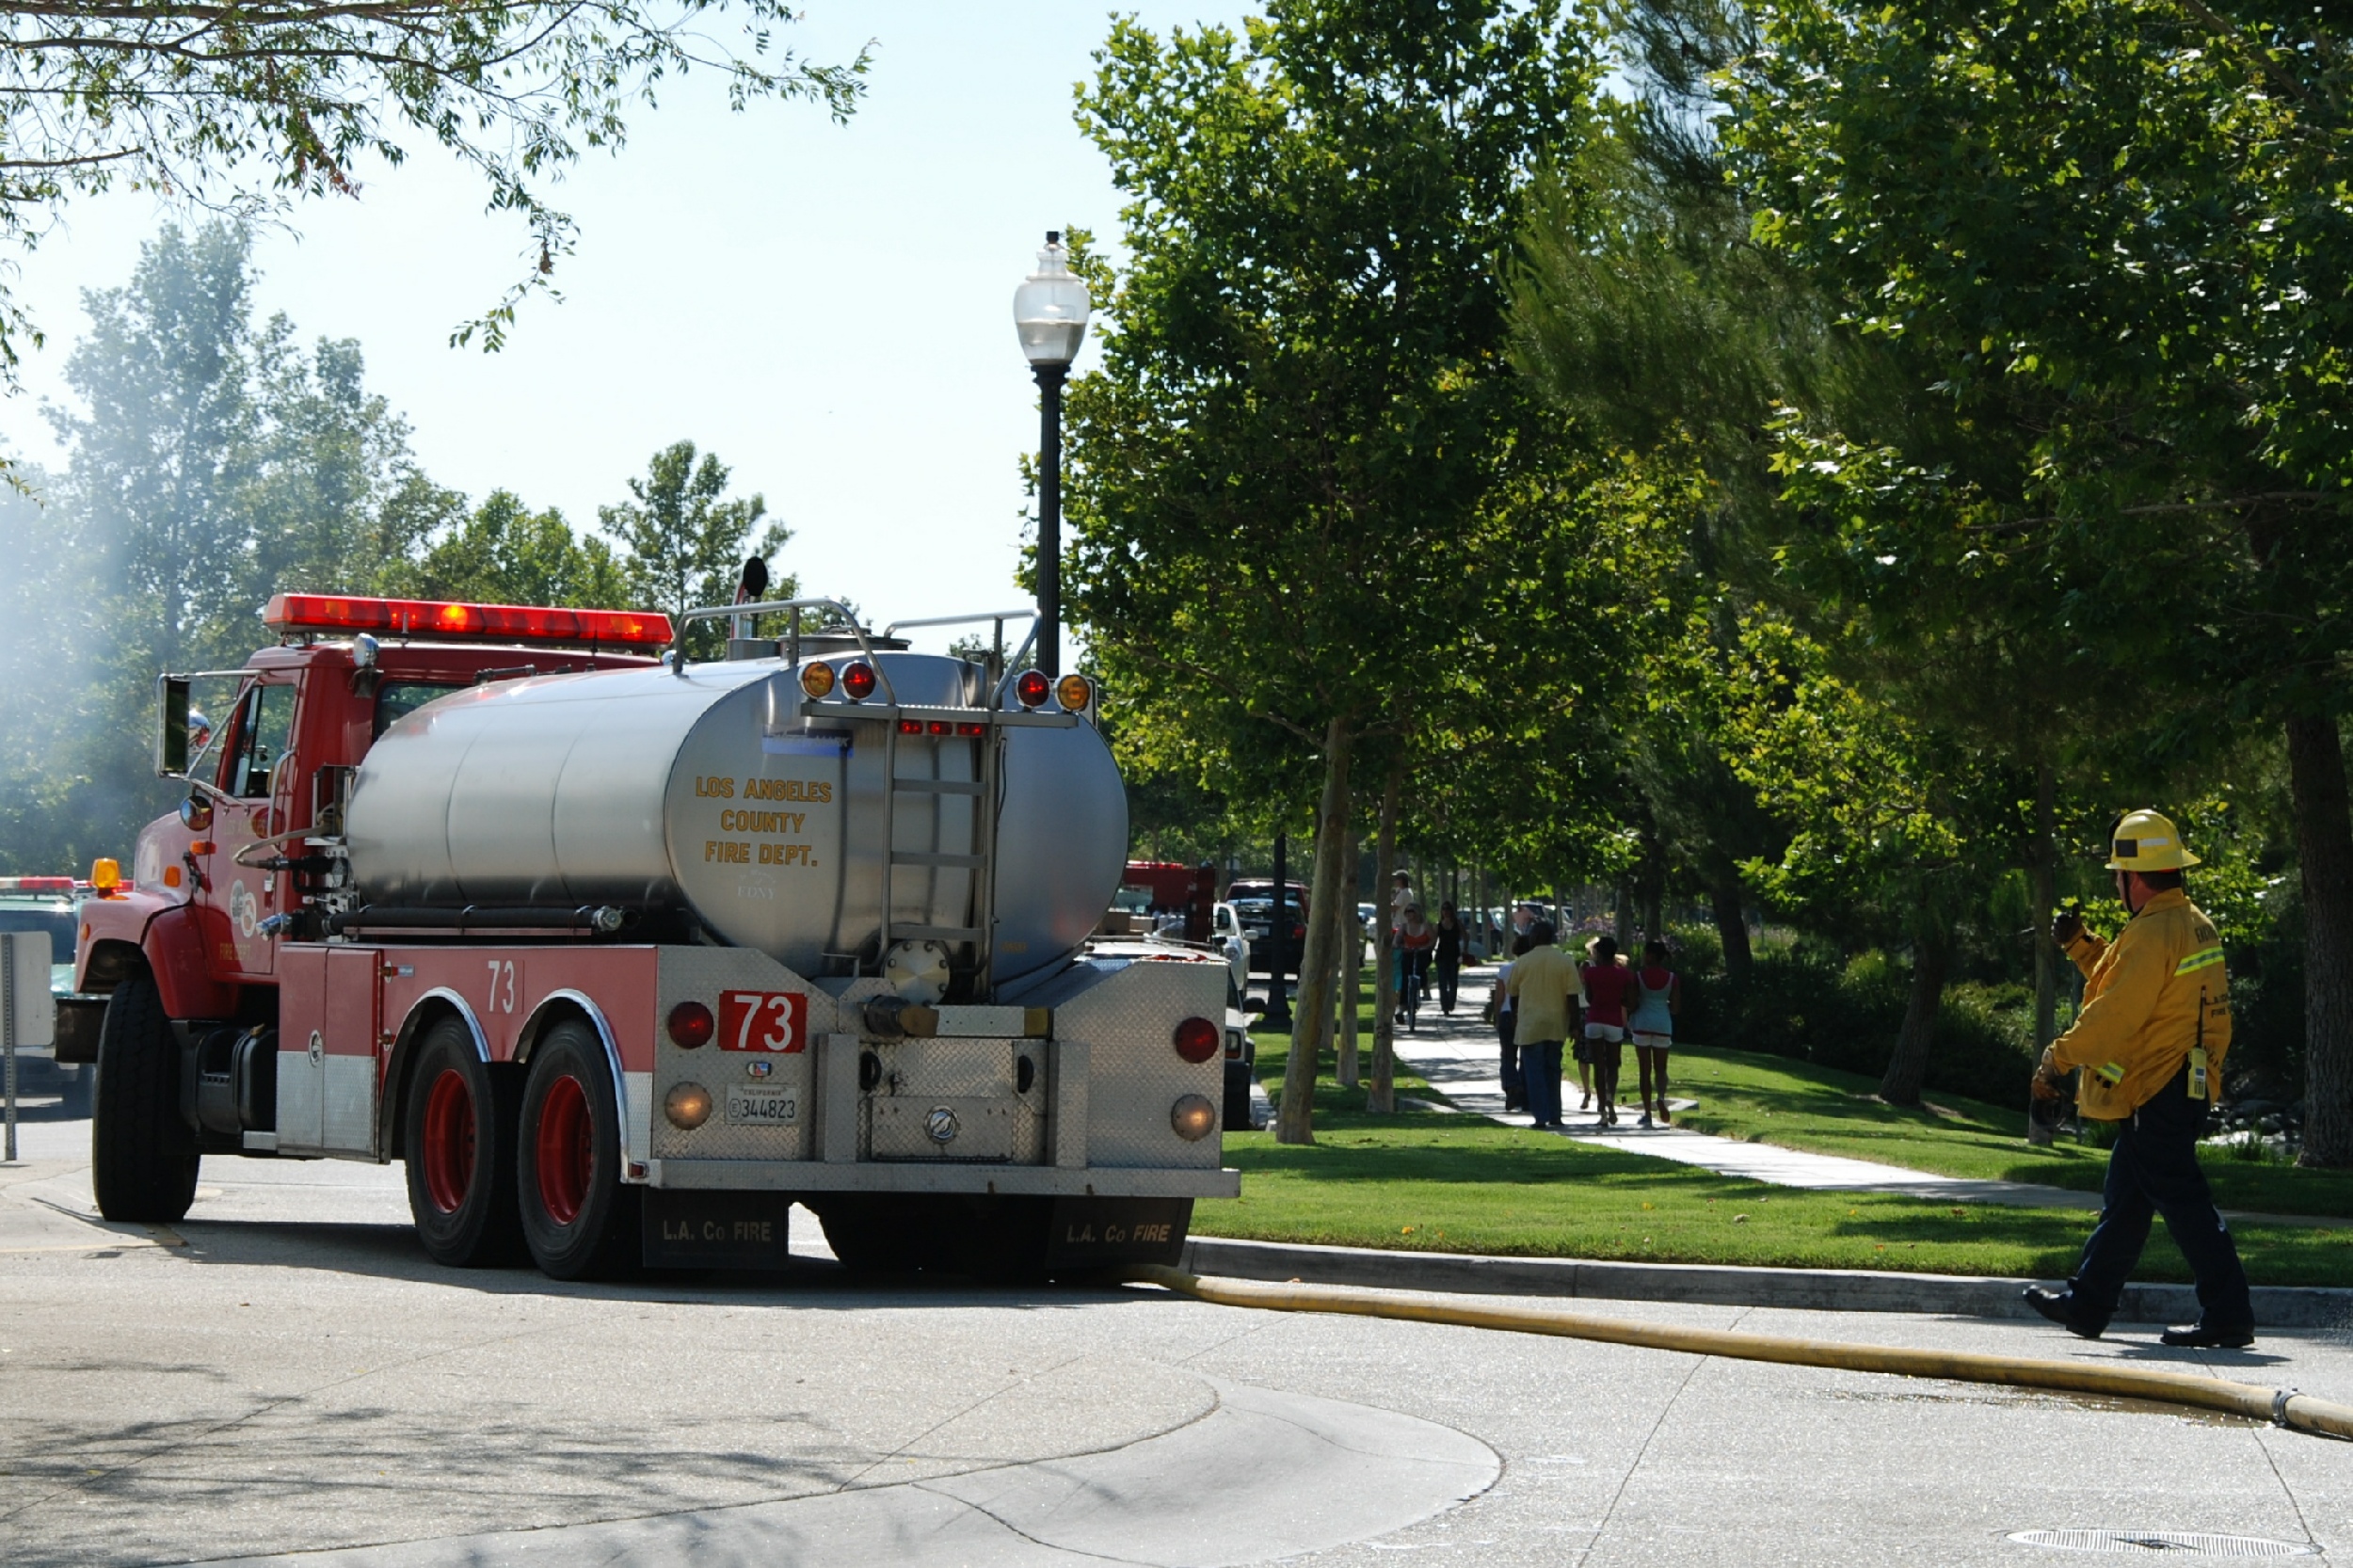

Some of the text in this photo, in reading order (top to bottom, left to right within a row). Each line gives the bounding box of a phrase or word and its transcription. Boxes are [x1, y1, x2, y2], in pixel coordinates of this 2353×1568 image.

[696, 776, 832, 803] LOS ANGELES
[721, 809, 806, 833] COUNTY
[705, 840, 818, 867] FIRE DEPT.
[488, 960, 514, 1014] 73
[734, 995, 792, 1050] 73
[742, 1099, 795, 1119] 344823
[664, 1220, 772, 1241] L.A. Co FIRE
[1066, 1224, 1171, 1242] L.A. Co FIRE
